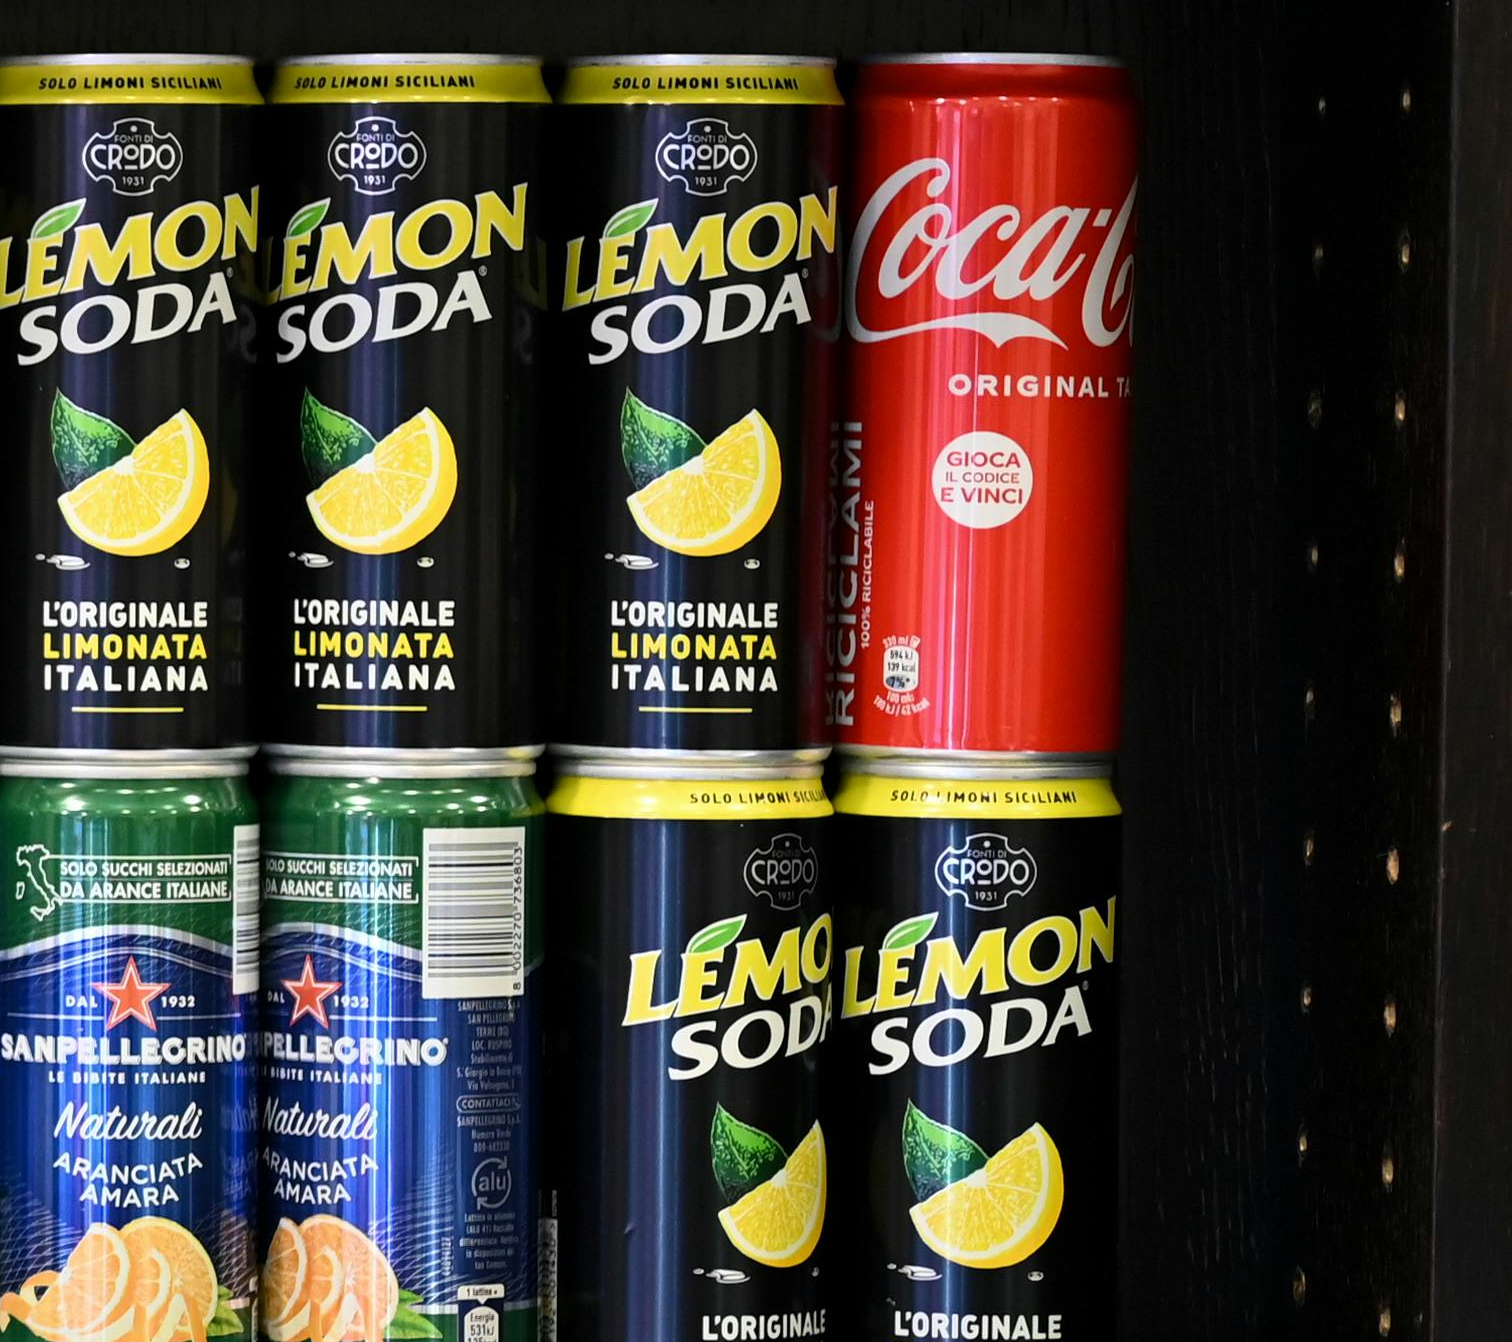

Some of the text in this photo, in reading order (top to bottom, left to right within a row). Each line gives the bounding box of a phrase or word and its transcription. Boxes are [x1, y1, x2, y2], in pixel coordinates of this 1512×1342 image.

[612, 75, 799, 90] SOLO LIMONI SICILIANI
[695, 175, 718, 187] 1931
[563, 186, 837, 312] LEMON
[589, 273, 812, 365] SODA
[948, 374, 1108, 397] ORIGINAL
[946, 452, 1021, 468] GIOCA
[611, 601, 778, 628] L'ORIGINALE
[611, 633, 776, 659] LIMONATA
[612, 664, 778, 692] ITALIANA
